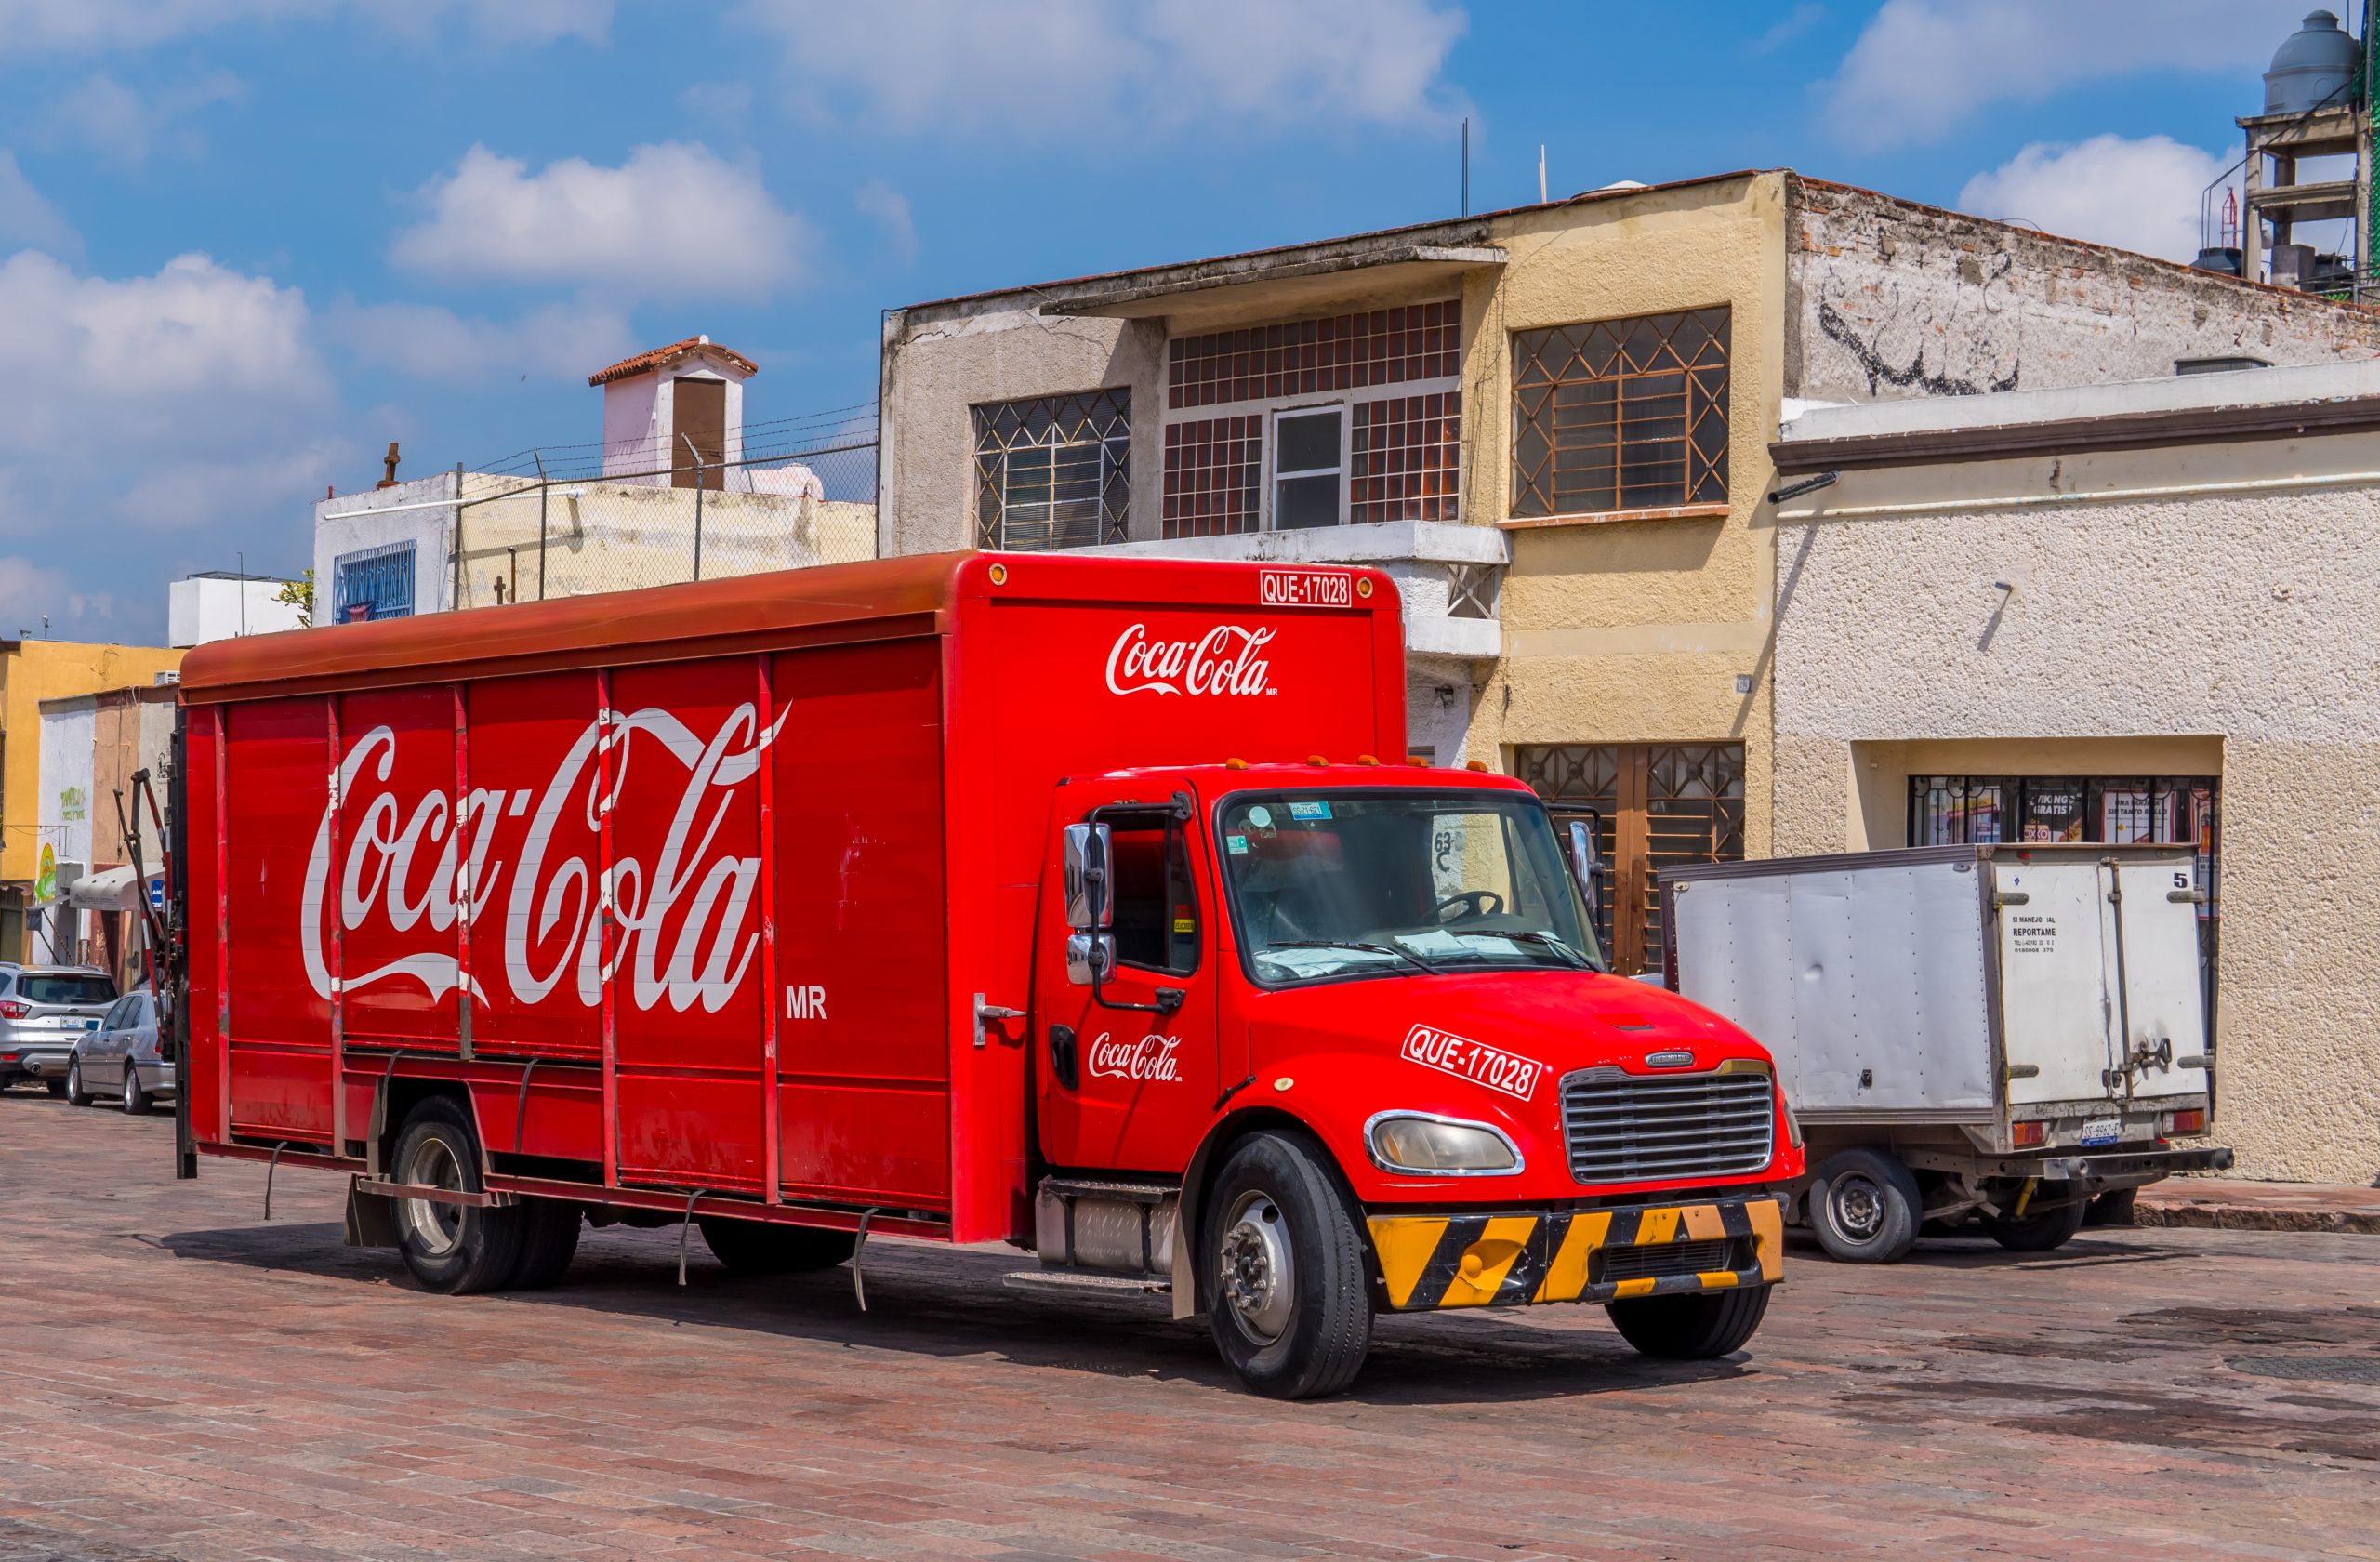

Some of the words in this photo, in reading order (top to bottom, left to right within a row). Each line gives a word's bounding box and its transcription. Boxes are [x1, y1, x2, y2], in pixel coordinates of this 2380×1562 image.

[1264, 574, 1347, 603] QUE-17028
[1105, 623, 1278, 697] Coca-Cola
[1265, 688, 1278, 696] MR
[300, 698, 794, 1013] Coca-Cola
[2173, 872, 2188, 889] 5
[2013, 928, 2056, 936] REPORTAME
[786, 985, 827, 1020] MR
[1088, 1032, 1182, 1081] Coca-Cola
[1409, 1029, 1533, 1094] QUE-17028
